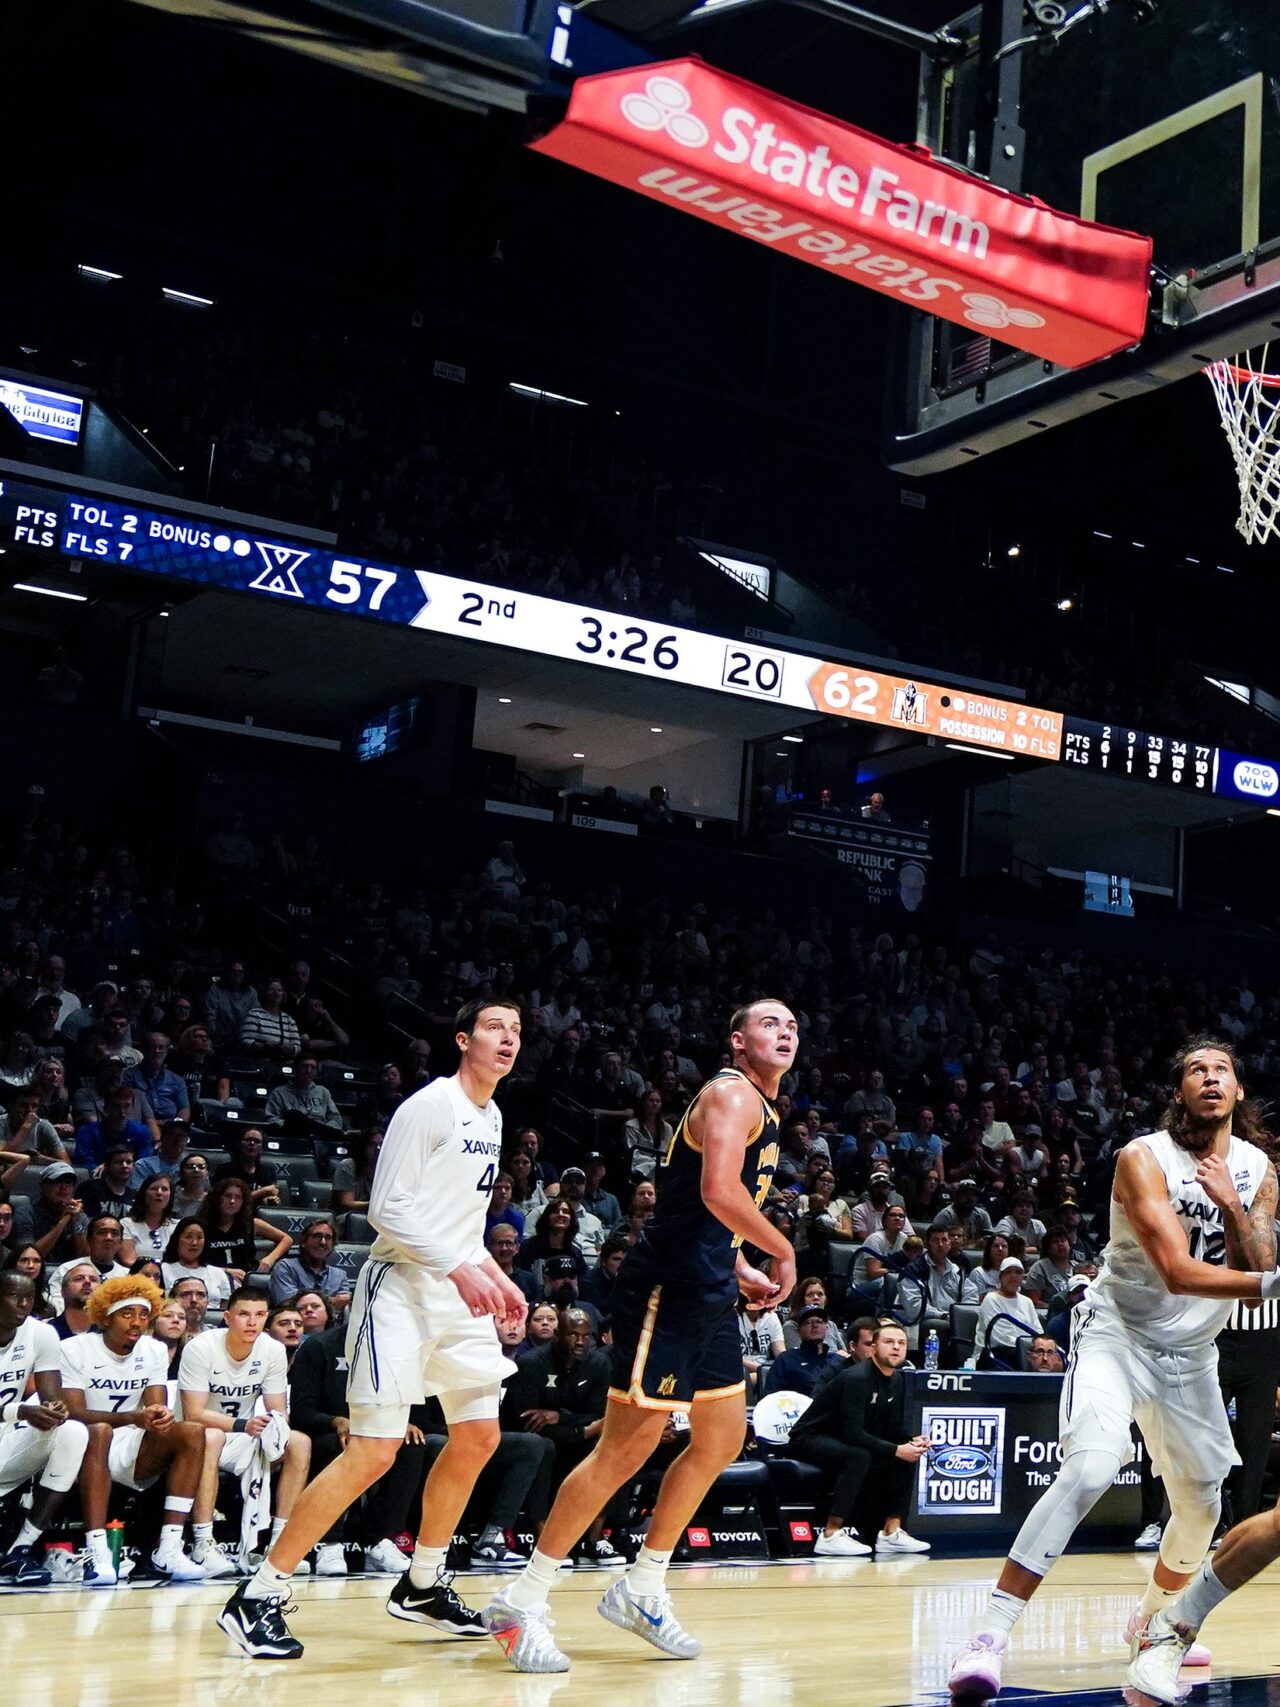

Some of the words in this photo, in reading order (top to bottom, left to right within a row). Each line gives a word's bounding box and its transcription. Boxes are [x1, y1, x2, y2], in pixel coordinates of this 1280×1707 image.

[53, 412, 76, 427] Ice
[16, 506, 58, 527] PTS
[70, 503, 113, 528] TOL
[121, 515, 138, 533] 2
[15, 526, 54, 548] FLS
[149, 520, 211, 548] BONUS
[66, 533, 108, 555] FLS
[118, 543, 133, 560] 7
[326, 559, 397, 610] 57
[458, 592, 516, 626] 2nd
[575, 616, 679, 670] 3:26
[726, 652, 780, 691] 20
[822, 671, 879, 715] 62
[966, 700, 1007, 721] BONUS
[1016, 711, 1027, 726] 2
[1032, 715, 1058, 732] TOL
[940, 718, 1005, 745] POSSESSION
[1012, 734, 1027, 750] 10
[1030, 738, 1056, 755] FLS
[1102, 726, 1112, 739] 2
[1127, 732, 1136, 744] 9
[1148, 736, 1163, 750] 33
[1171, 741, 1187, 755] 34
[1195, 746, 1210, 760] 77
[1065, 748, 1089, 764] FLS
[1102, 755, 1108, 768] 1
[1126, 760, 1132, 773] 1
[1066, 733, 1090, 749] PTS
[1127, 746, 1134, 759] 1
[1195, 760, 1208, 774] 10
[1239, 776, 1273, 791] WLW
[1244, 766, 1270, 778] 700
[837, 849, 896, 870] REPUBLIC
[476, 1163, 495, 1198] 4
[1176, 1199, 1224, 1223] XAVI
[210, 1238, 245, 1249] XAVIER
[1188, 1226, 1226, 1266] 12
[88, 1377, 149, 1390] XAVIER
[208, 1382, 262, 1397] XAVIER
[927, 1373, 972, 1391] anc
[109, 1394, 130, 1413] 7
[220, 1401, 241, 1418] 3
[930, 1419, 996, 1446] BUILT
[945, 1456, 977, 1471] Ford
[928, 1480, 992, 1501] TOUGH
[1026, 1471, 1051, 1486] The
[712, 1532, 761, 1542] TOYOTA
